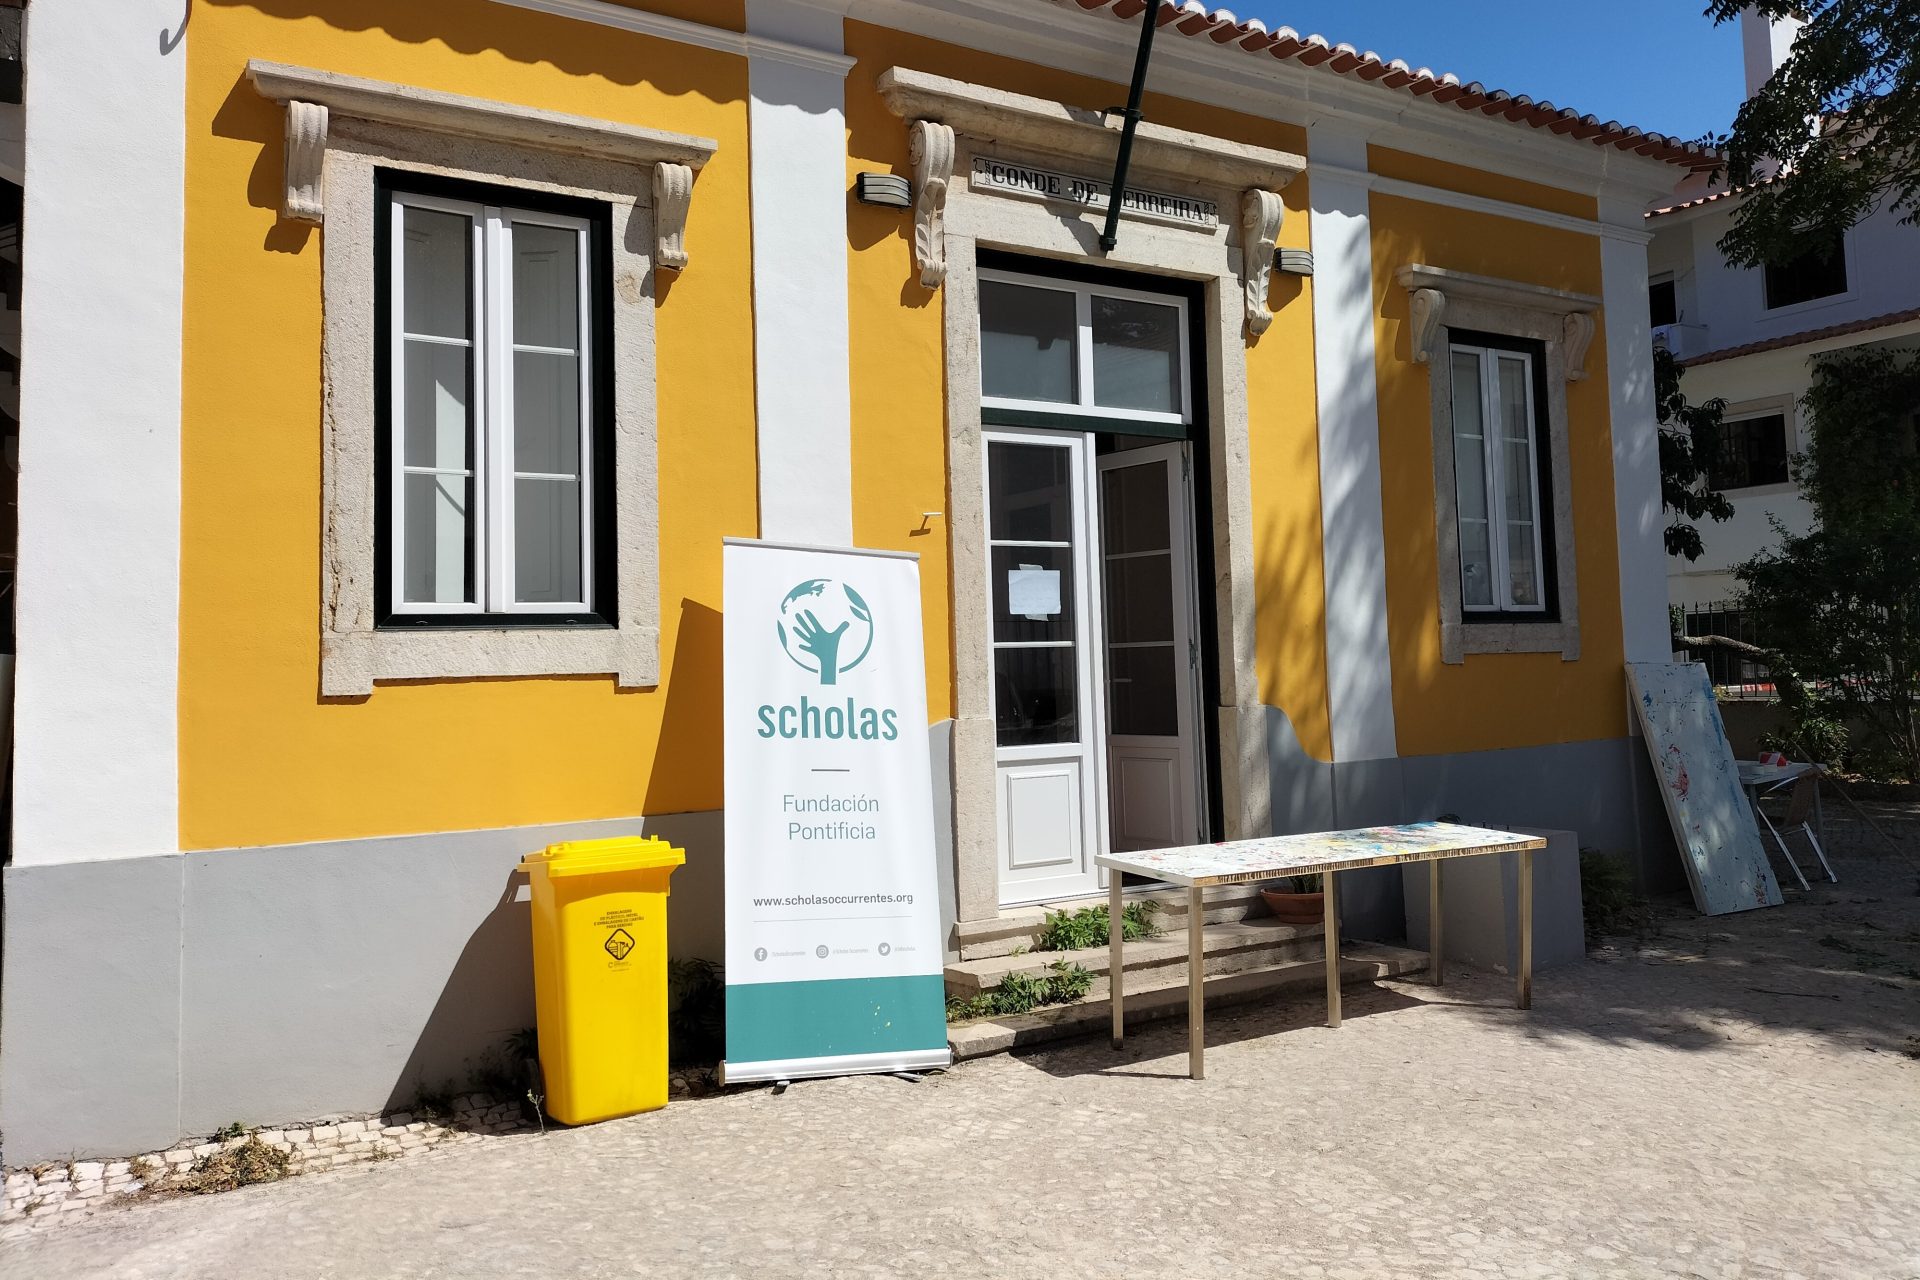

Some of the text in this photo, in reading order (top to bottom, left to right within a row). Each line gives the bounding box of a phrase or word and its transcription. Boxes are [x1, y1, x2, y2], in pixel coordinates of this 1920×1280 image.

[992, 165, 1204, 221] CONDE DE ERREIRA
[757, 695, 898, 741] scholas
[783, 794, 880, 812] Fundación
[788, 822, 876, 840] Pontificia
[753, 893, 914, 907] www.scholasoccurrentes.org
